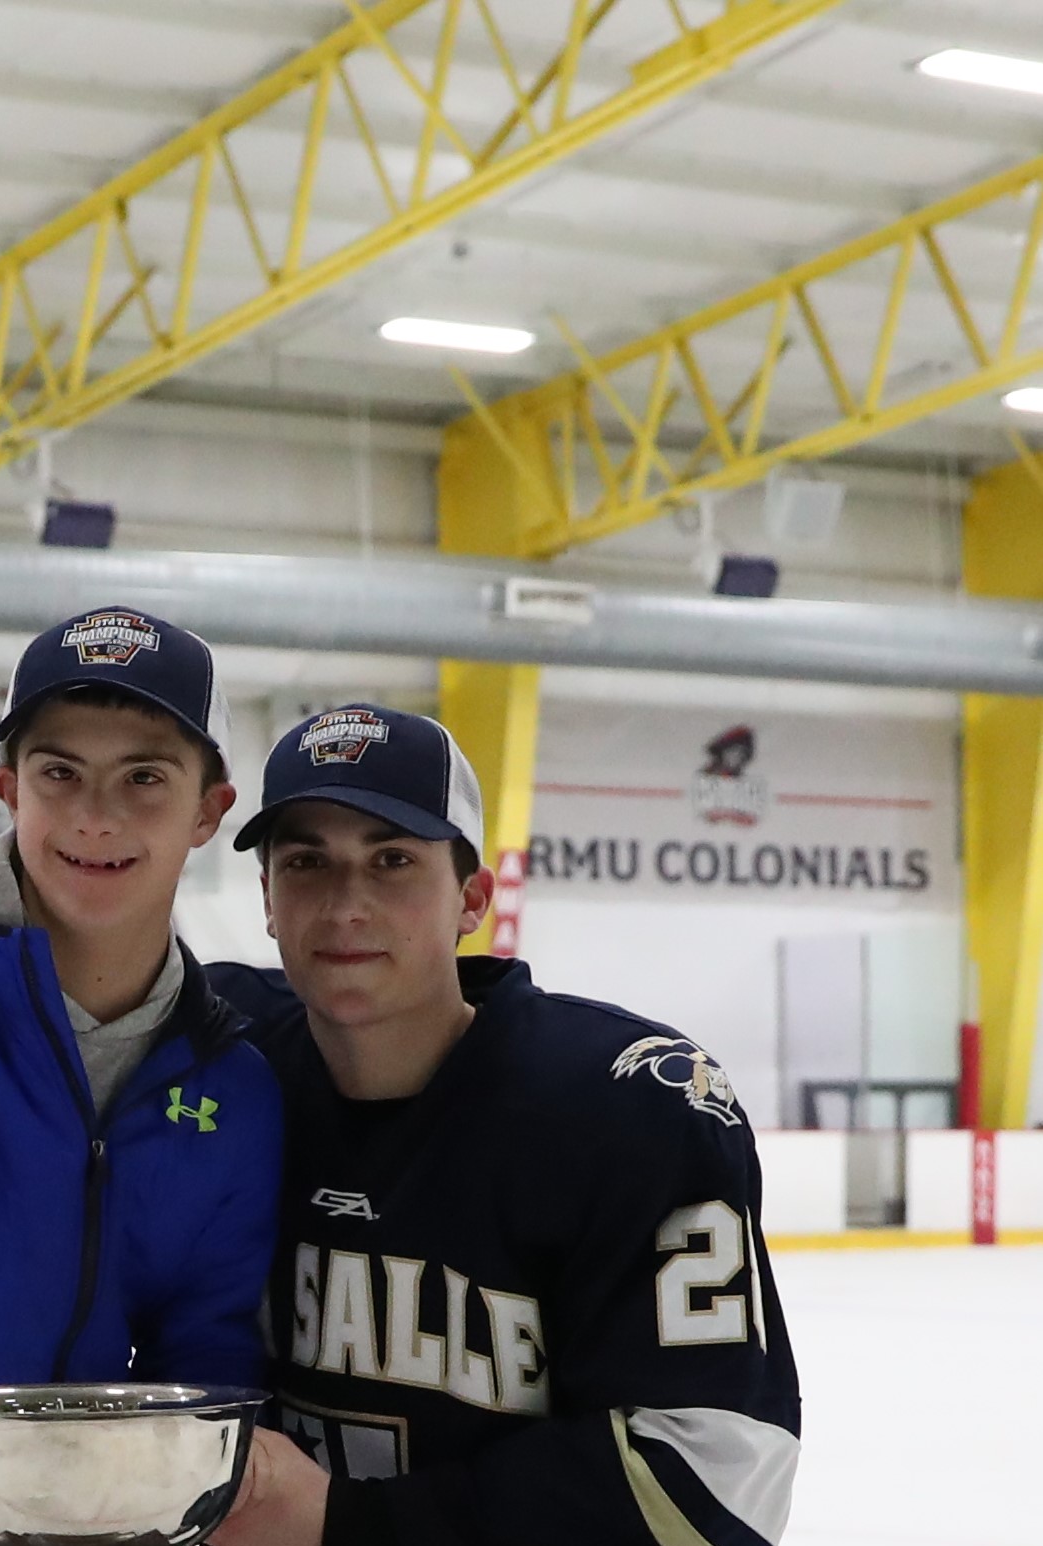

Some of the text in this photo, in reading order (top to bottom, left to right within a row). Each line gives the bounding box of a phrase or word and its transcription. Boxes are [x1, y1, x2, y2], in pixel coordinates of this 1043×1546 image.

[95, 617, 131, 627] STATE
[66, 626, 157, 647] CHAMPIONS
[326, 714, 361, 725] STATE
[302, 722, 384, 747] CHAMPIONS
[528, 835, 931, 892] RMU COLONIALS
[291, 1242, 550, 1418] SALLE
